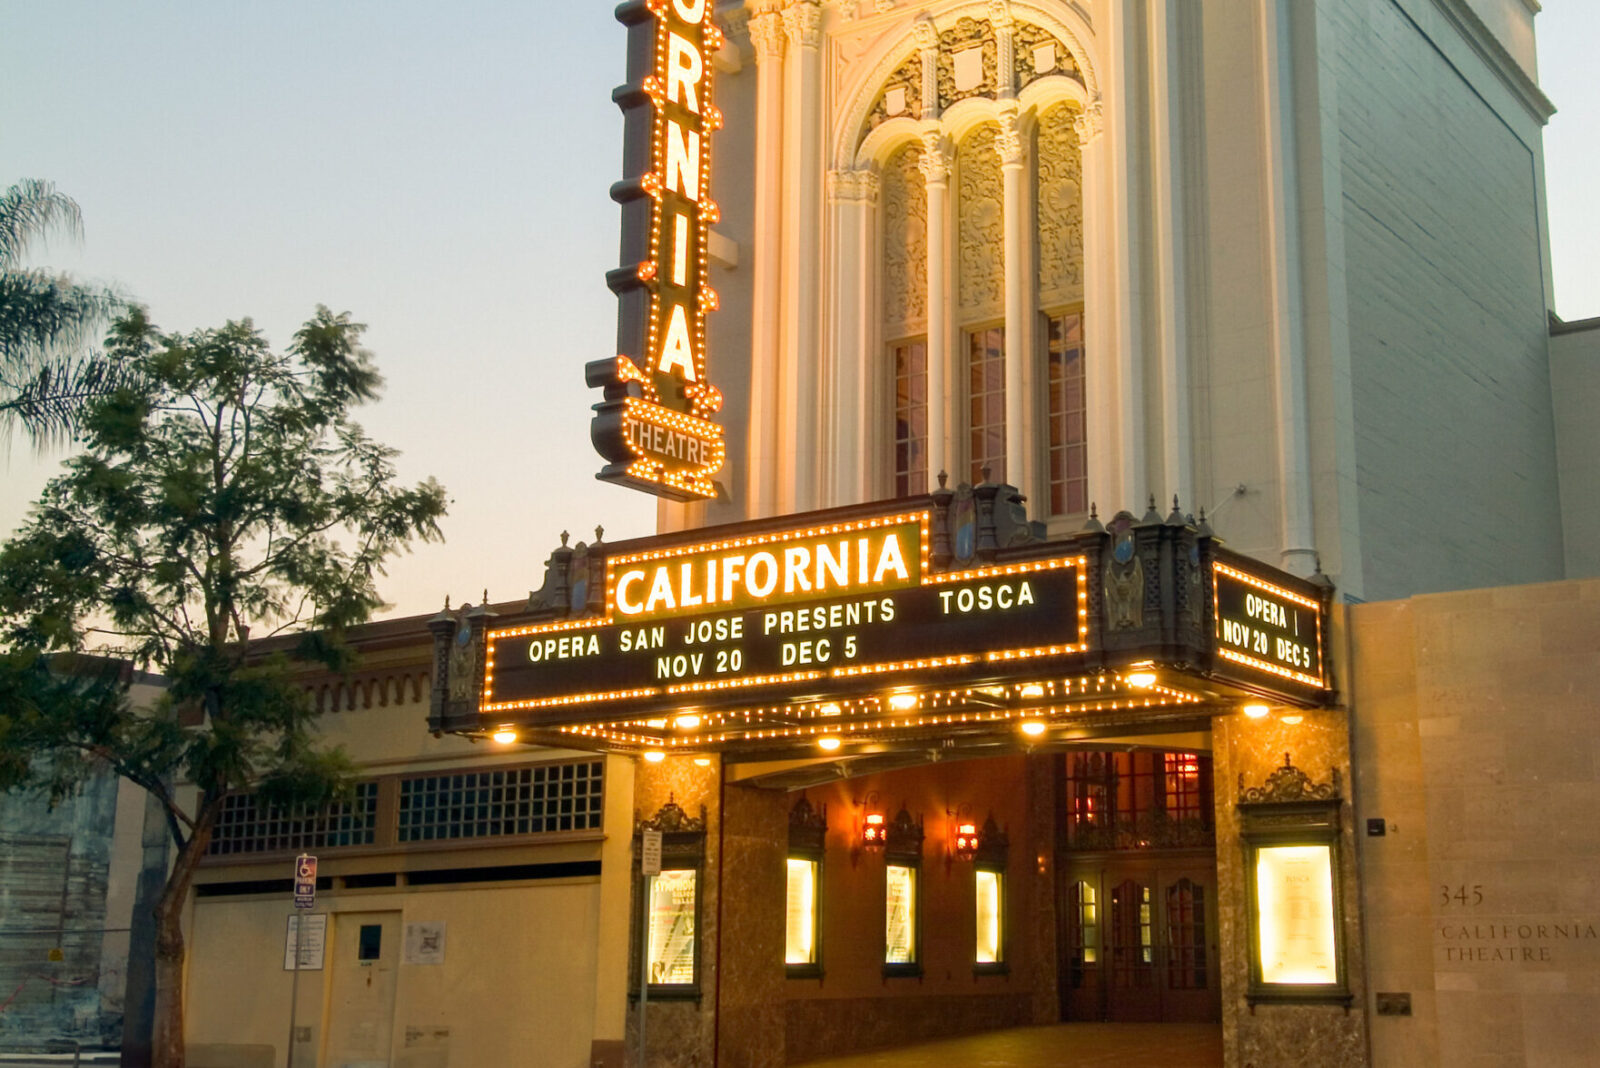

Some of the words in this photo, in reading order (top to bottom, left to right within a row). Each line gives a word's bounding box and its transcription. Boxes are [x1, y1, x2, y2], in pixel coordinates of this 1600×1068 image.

[627, 418, 711, 467] THEATRE
[615, 533, 909, 615] CALIFORNIA
[528, 634, 601, 662] OPERA
[619, 626, 665, 651] SAN
[685, 616, 743, 645] JOSE
[764, 598, 896, 636] PRESENTS
[939, 581, 1035, 614] TOSCA
[1245, 593, 1287, 629] OPERA
[657, 653, 704, 679] NOV
[716, 649, 743, 673] 20
[782, 638, 831, 666] DEC
[844, 636, 857, 659] 5
[1223, 618, 1250, 649] NOV
[1253, 630, 1268, 655] 20
[1276, 637, 1301, 667] DEC
[1303, 646, 1310, 669] 5
[1440, 885, 1484, 906] 345
[1441, 924, 1598, 940] CALIFORNIA
[1446, 946, 1552, 962] THEATRE
